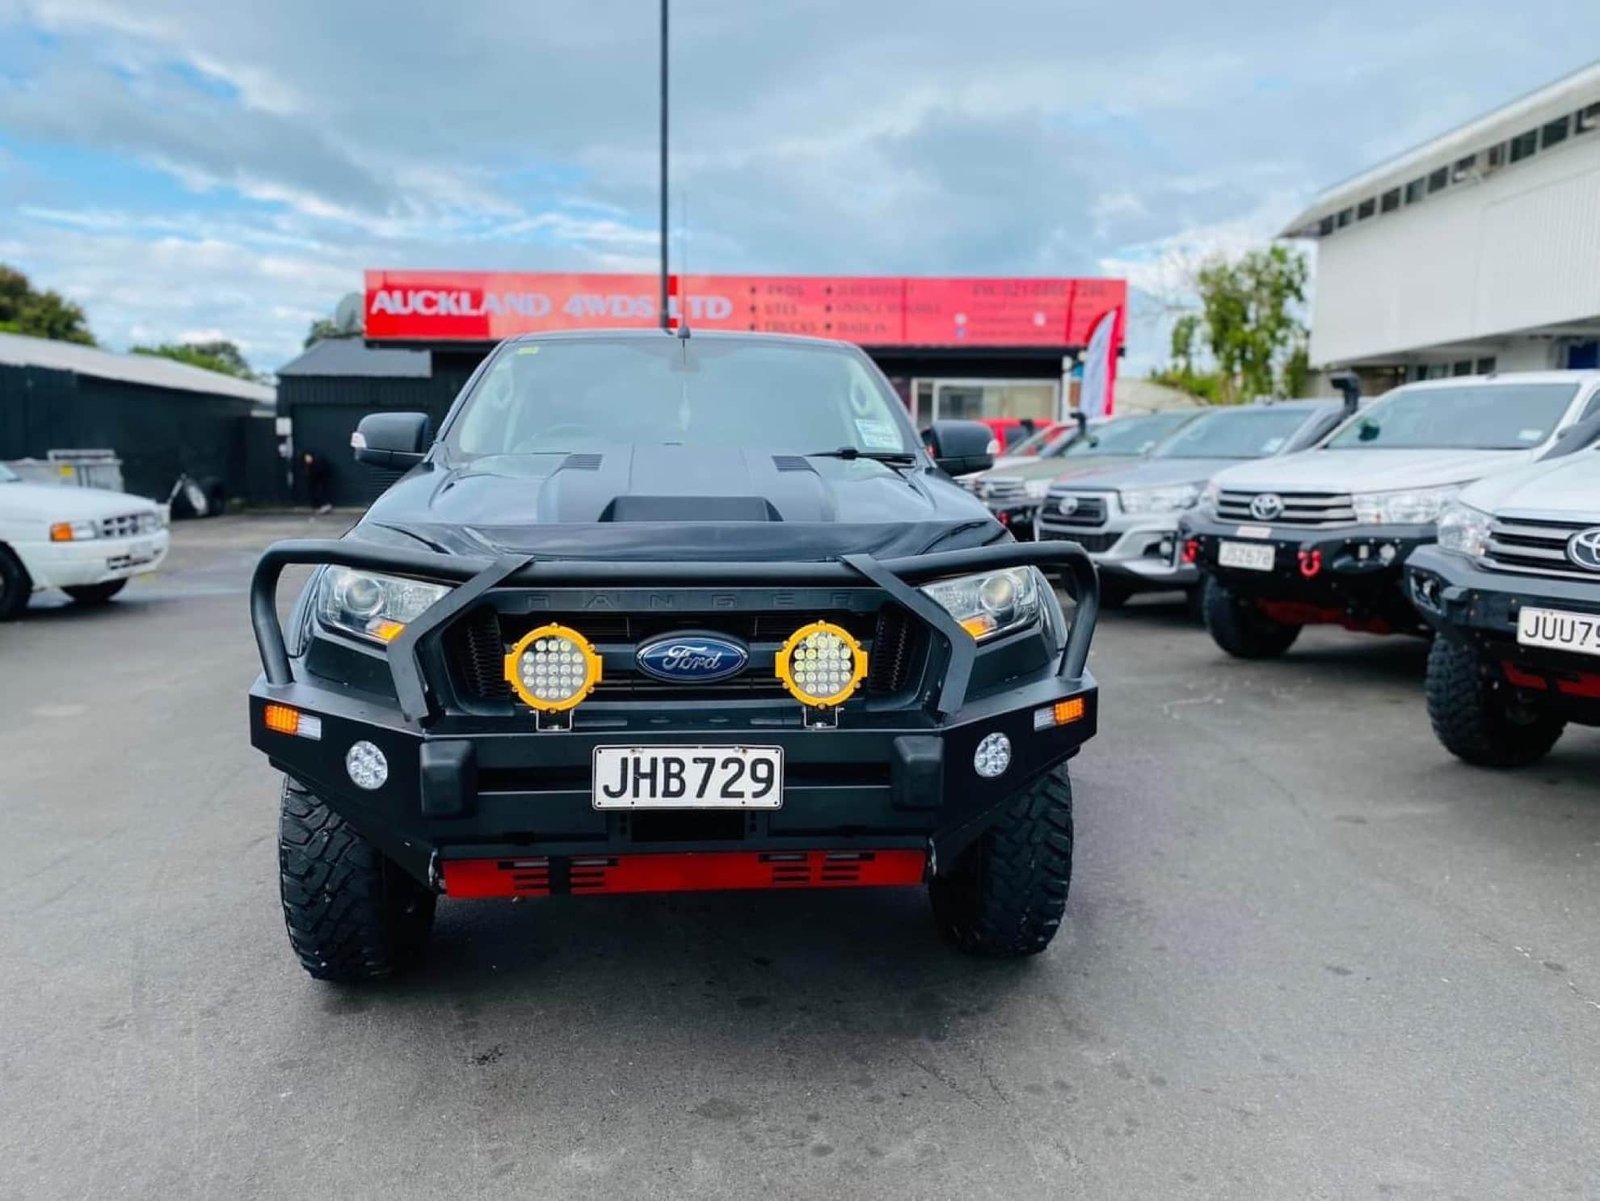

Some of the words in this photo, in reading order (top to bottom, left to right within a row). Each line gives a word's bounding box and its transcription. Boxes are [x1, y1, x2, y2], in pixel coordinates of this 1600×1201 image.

[370, 289, 551, 317] AUCKLAND
[562, 292, 656, 319] 4WDS
[668, 294, 732, 320] LTD
[526, 592, 854, 610] RANGER
[662, 644, 723, 672] Ford
[603, 756, 775, 799] JHB729
